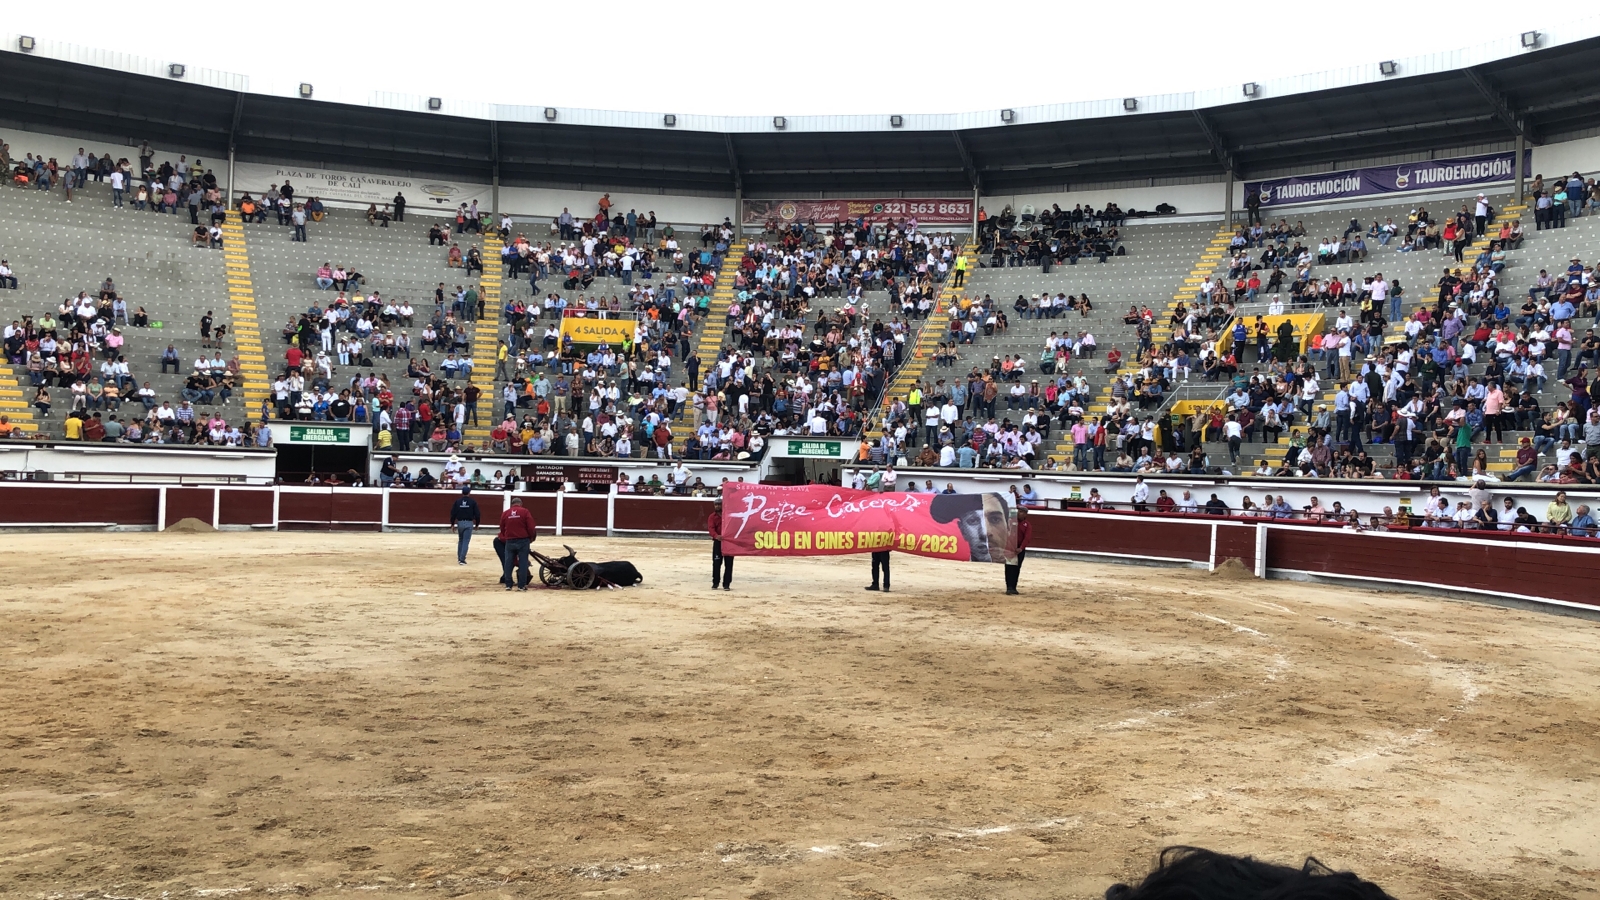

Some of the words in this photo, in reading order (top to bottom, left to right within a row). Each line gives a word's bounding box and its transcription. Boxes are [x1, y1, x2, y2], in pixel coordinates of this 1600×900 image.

[276, 169, 302, 178] PLAZA
[321, 173, 347, 182] TOROS
[350, 176, 412, 188] CAÑAVERALEJO
[1415, 159, 1512, 184] TAUROEMOCIÓN
[1276, 176, 1361, 200] TAUROEMOCIÓN
[884, 203, 906, 214] 321
[910, 203, 935, 214] 563
[939, 203, 970, 214] 8631
[575, 326, 581, 334] 4
[584, 326, 618, 335] SALIDA
[729, 492, 813, 539] Pepe
[754, 531, 790, 549] SOLO
[794, 531, 811, 549] EN
[815, 531, 854, 549] CINES
[897, 533, 958, 554] 19/2023
